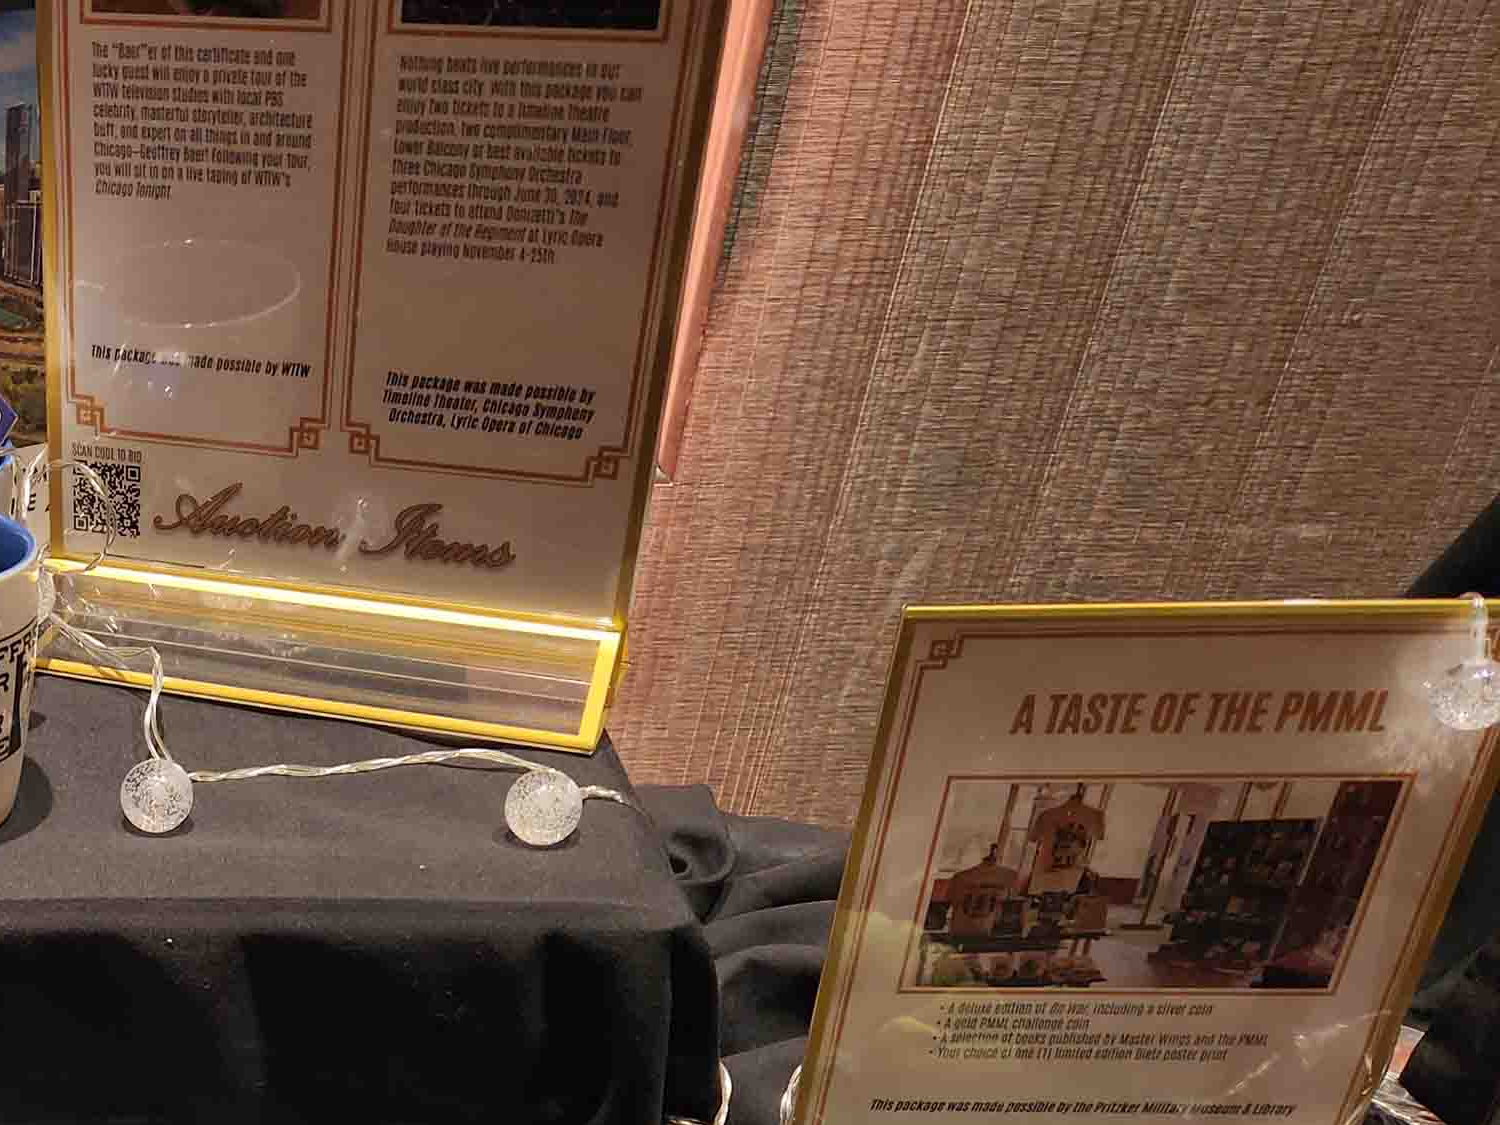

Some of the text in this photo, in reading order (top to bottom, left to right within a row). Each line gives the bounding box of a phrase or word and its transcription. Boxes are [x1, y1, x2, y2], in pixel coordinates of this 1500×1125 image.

[95, 163, 111, 179] you
[115, 163, 131, 178] will
[134, 164, 146, 178] sit
[150, 165, 158, 179] in
[162, 166, 174, 180] on
[178, 168, 183, 181] a
[186, 167, 203, 183] live
[207, 169, 238, 186] taping
[241, 170, 252, 185] of
[393, 159, 420, 176] three
[424, 161, 467, 179] Chicago
[96, 180, 171, 200] Chicago Tonight
[92, 344, 111, 359] This
[216, 356, 260, 373] possible
[265, 361, 277, 376] by
[387, 371, 596, 404] This package was made possible by
[383, 389, 429, 407] Timeline
[433, 392, 478, 413] Theater,
[483, 399, 529, 417] Chicago
[389, 408, 583, 440] Orchestra, Lyric Opera of Chicago
[1009, 689, 1389, 735] A TASTE OF THE PMML
[944, 1018, 951, 1029] A
[1012, 1018, 1064, 1030] challenge
[1066, 1018, 1090, 1030] coin
[870, 1099, 894, 1112] This
[895, 1100, 945, 1113] package
[948, 1101, 969, 1112] was
[971, 1101, 1003, 1112] made
[1004, 1101, 1055, 1114] possible
[1056, 1102, 1072, 1114] by
[1073, 1101, 1093, 1113] the
[1093, 1102, 1141, 1113] Pritzker
[1252, 1104, 1297, 1116] Library
